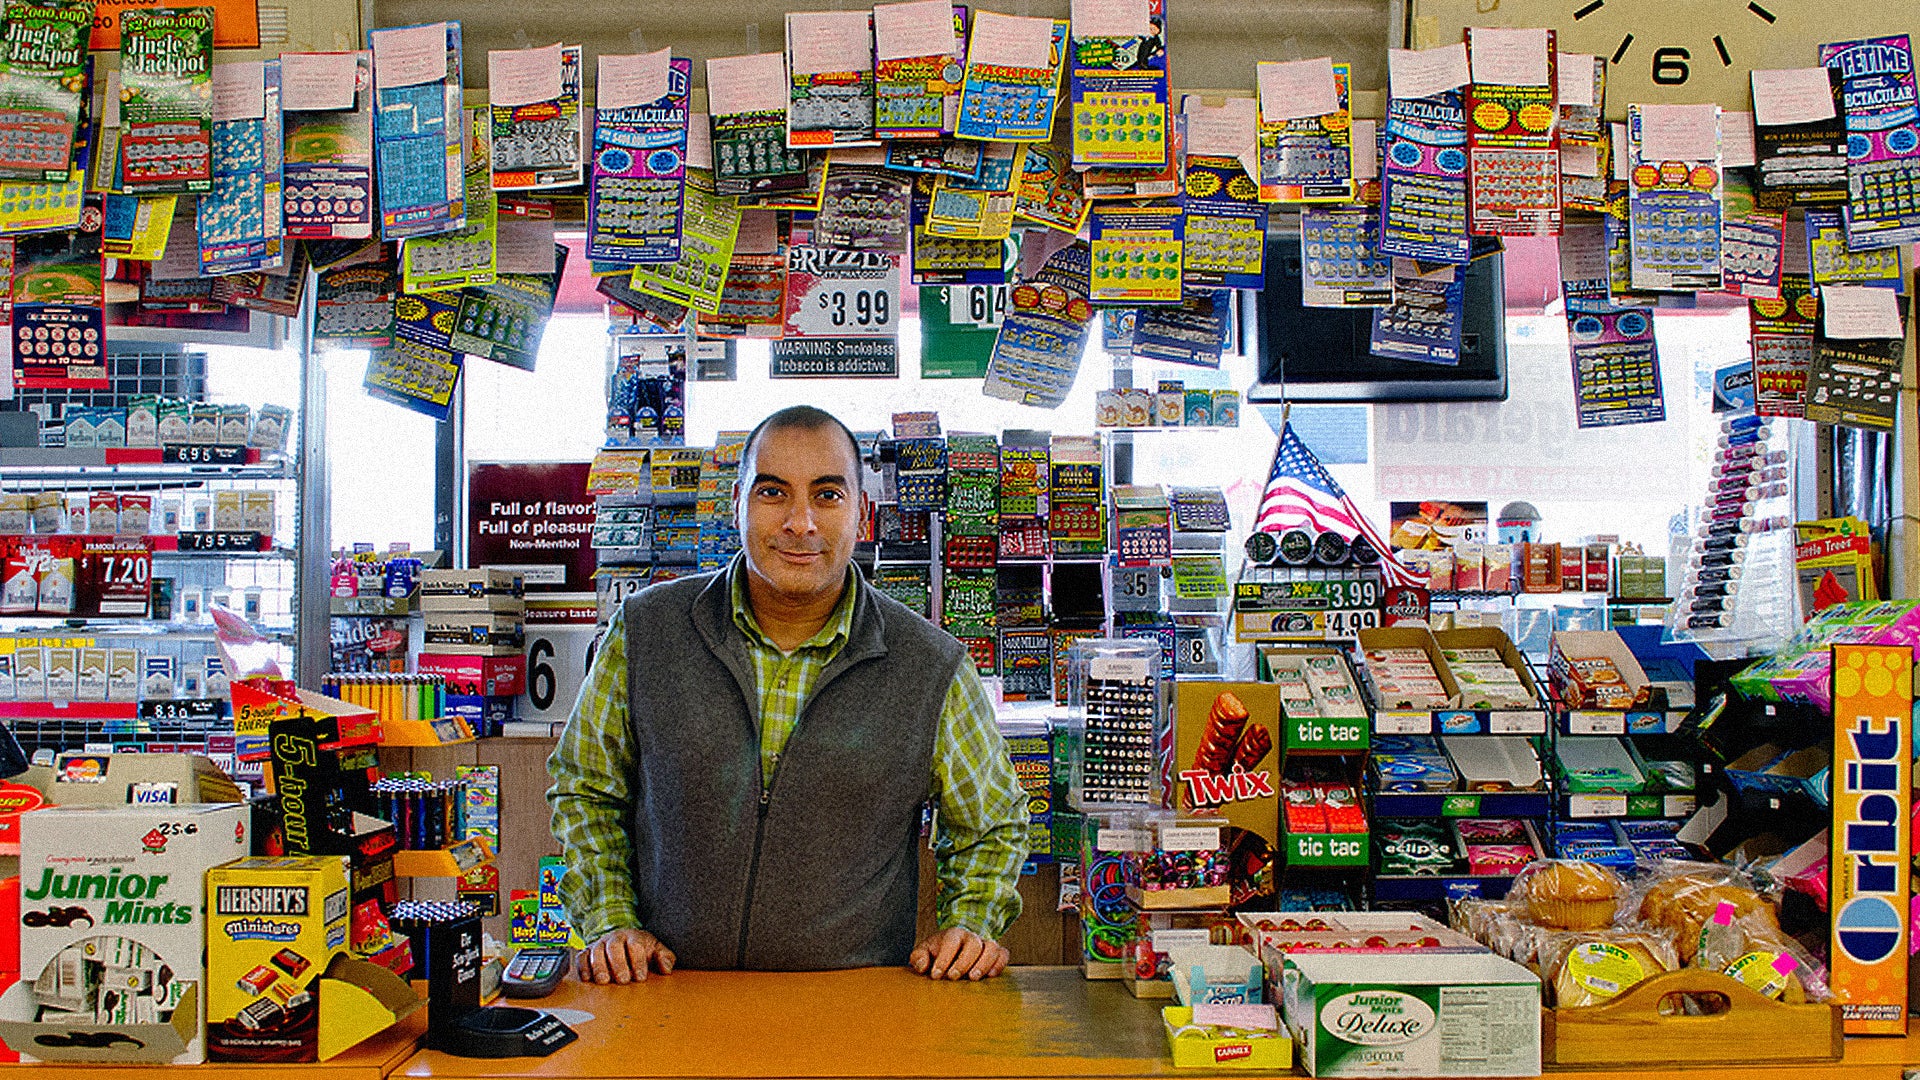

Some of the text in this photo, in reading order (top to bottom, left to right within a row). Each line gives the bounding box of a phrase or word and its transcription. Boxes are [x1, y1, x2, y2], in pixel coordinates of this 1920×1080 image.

[5, 22, 60, 45] Jingle
[128, 33, 183, 55] Jingle
[9, 41, 81, 69] Jackpot
[134, 54, 206, 78] Jackpot
[973, 63, 1055, 79] JACKPOT
[1652, 47, 1691, 85] 6
[599, 108, 684, 123] SPECTACULAR
[1391, 98, 1464, 121] SPECTACULA
[788, 245, 892, 277] GRIZZLY
[774, 340, 895, 357] WARNING: Smokeless
[779, 357, 890, 373] tobacco is addictive.
[491, 502, 597, 515] Full of flavor!
[479, 520, 596, 536] Full of pleasur
[194, 534, 226, 548] 7.95
[510, 539, 580, 549] Non-Menthol
[1825, 538, 1852, 552] Trees
[1123, 573, 1148, 597] 35
[1238, 584, 1261, 596] NEW
[1326, 581, 1376, 608] $3.99
[1298, 721, 1360, 741] tic tac
[1180, 762, 1275, 806] Twix
[136, 790, 169, 804] VISA
[1298, 838, 1360, 857] tic tac
[1385, 842, 1450, 856] eclipse
[24, 868, 169, 901] Junior
[219, 888, 306, 914] HERSHEY'S
[103, 900, 193, 925] Mints
[1348, 994, 1403, 1007] Junior
[1369, 1005, 1404, 1014] Mints
[1336, 1011, 1421, 1037] Deluxe
